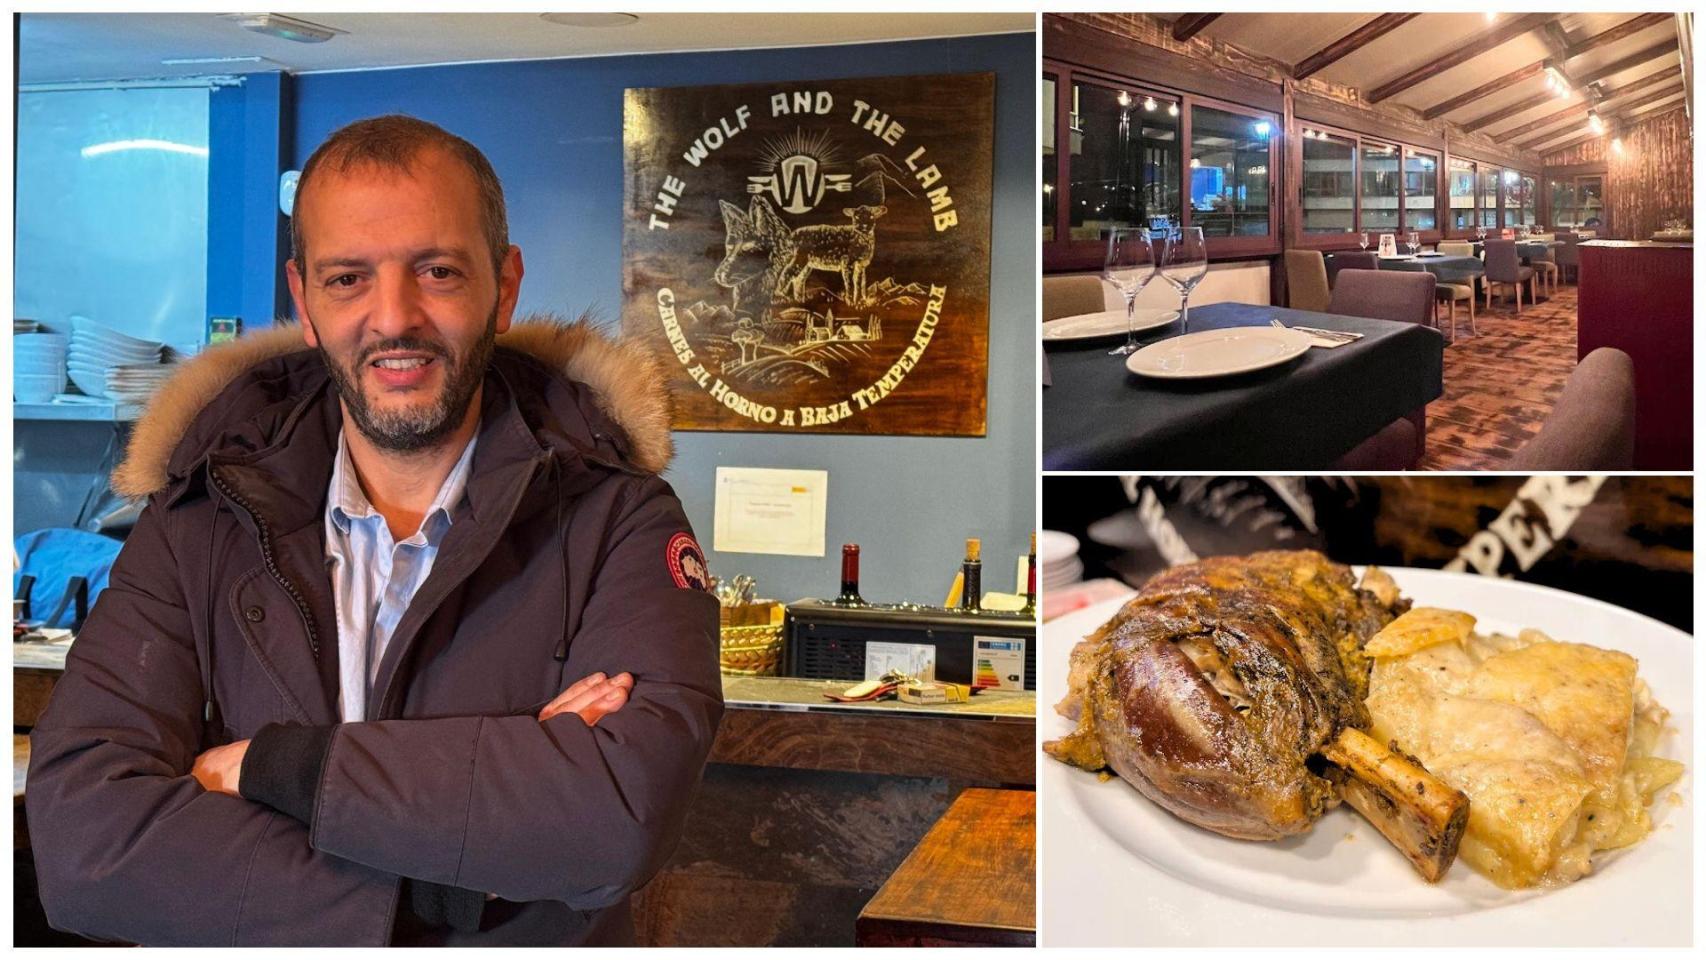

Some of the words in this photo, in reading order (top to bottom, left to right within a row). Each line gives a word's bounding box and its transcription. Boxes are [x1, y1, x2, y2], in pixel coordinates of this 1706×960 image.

[649, 175, 686, 231] THE
[683, 104, 751, 168] WOLF
[771, 91, 834, 118] AND
[851, 99, 906, 147] THE
[905, 145, 958, 232] LAMB
[657, 287, 696, 365] CARNES
[687, 363, 711, 389] AL
[709, 378, 777, 423] HORNO
[780, 409, 795, 427] A
[800, 400, 853, 427] BAJA
[852, 283, 947, 411] TEMPERATURA
